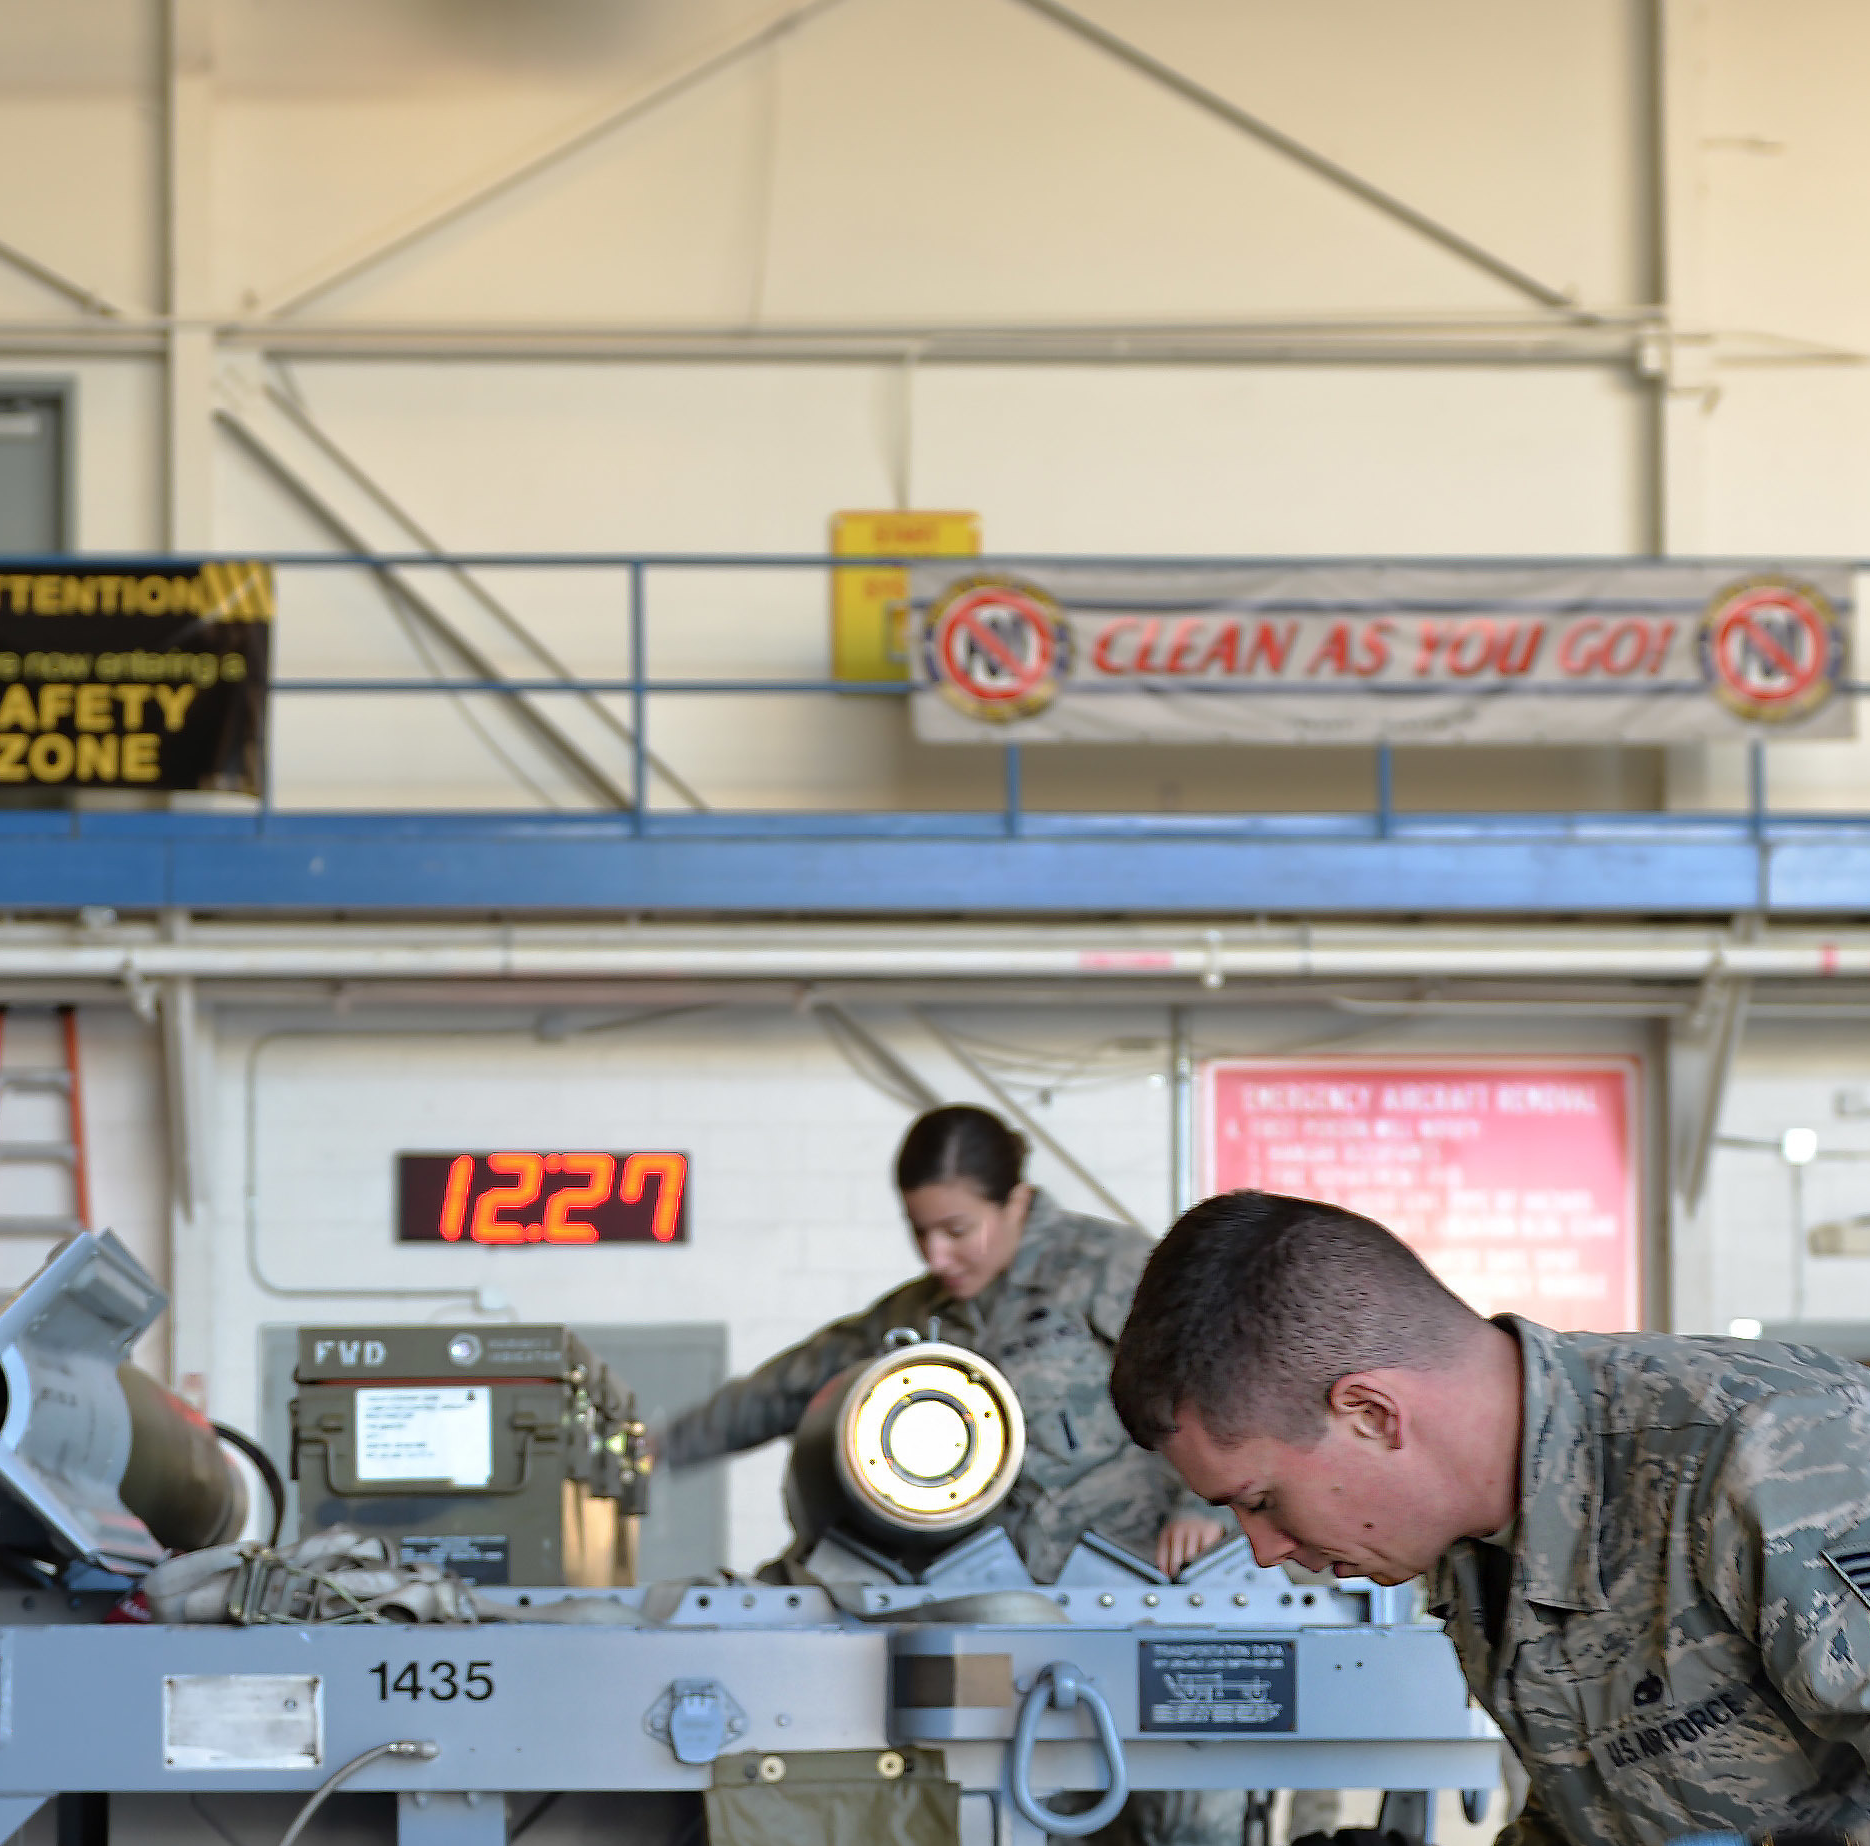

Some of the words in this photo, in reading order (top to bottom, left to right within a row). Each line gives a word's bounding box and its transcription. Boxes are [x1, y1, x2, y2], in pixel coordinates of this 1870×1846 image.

[1091, 617, 1298, 676] CLEAN
[1306, 617, 1395, 677] AS
[1414, 617, 1547, 676] YOU
[1556, 617, 1677, 676] GO!
[368, 1659, 495, 1702] 1435
